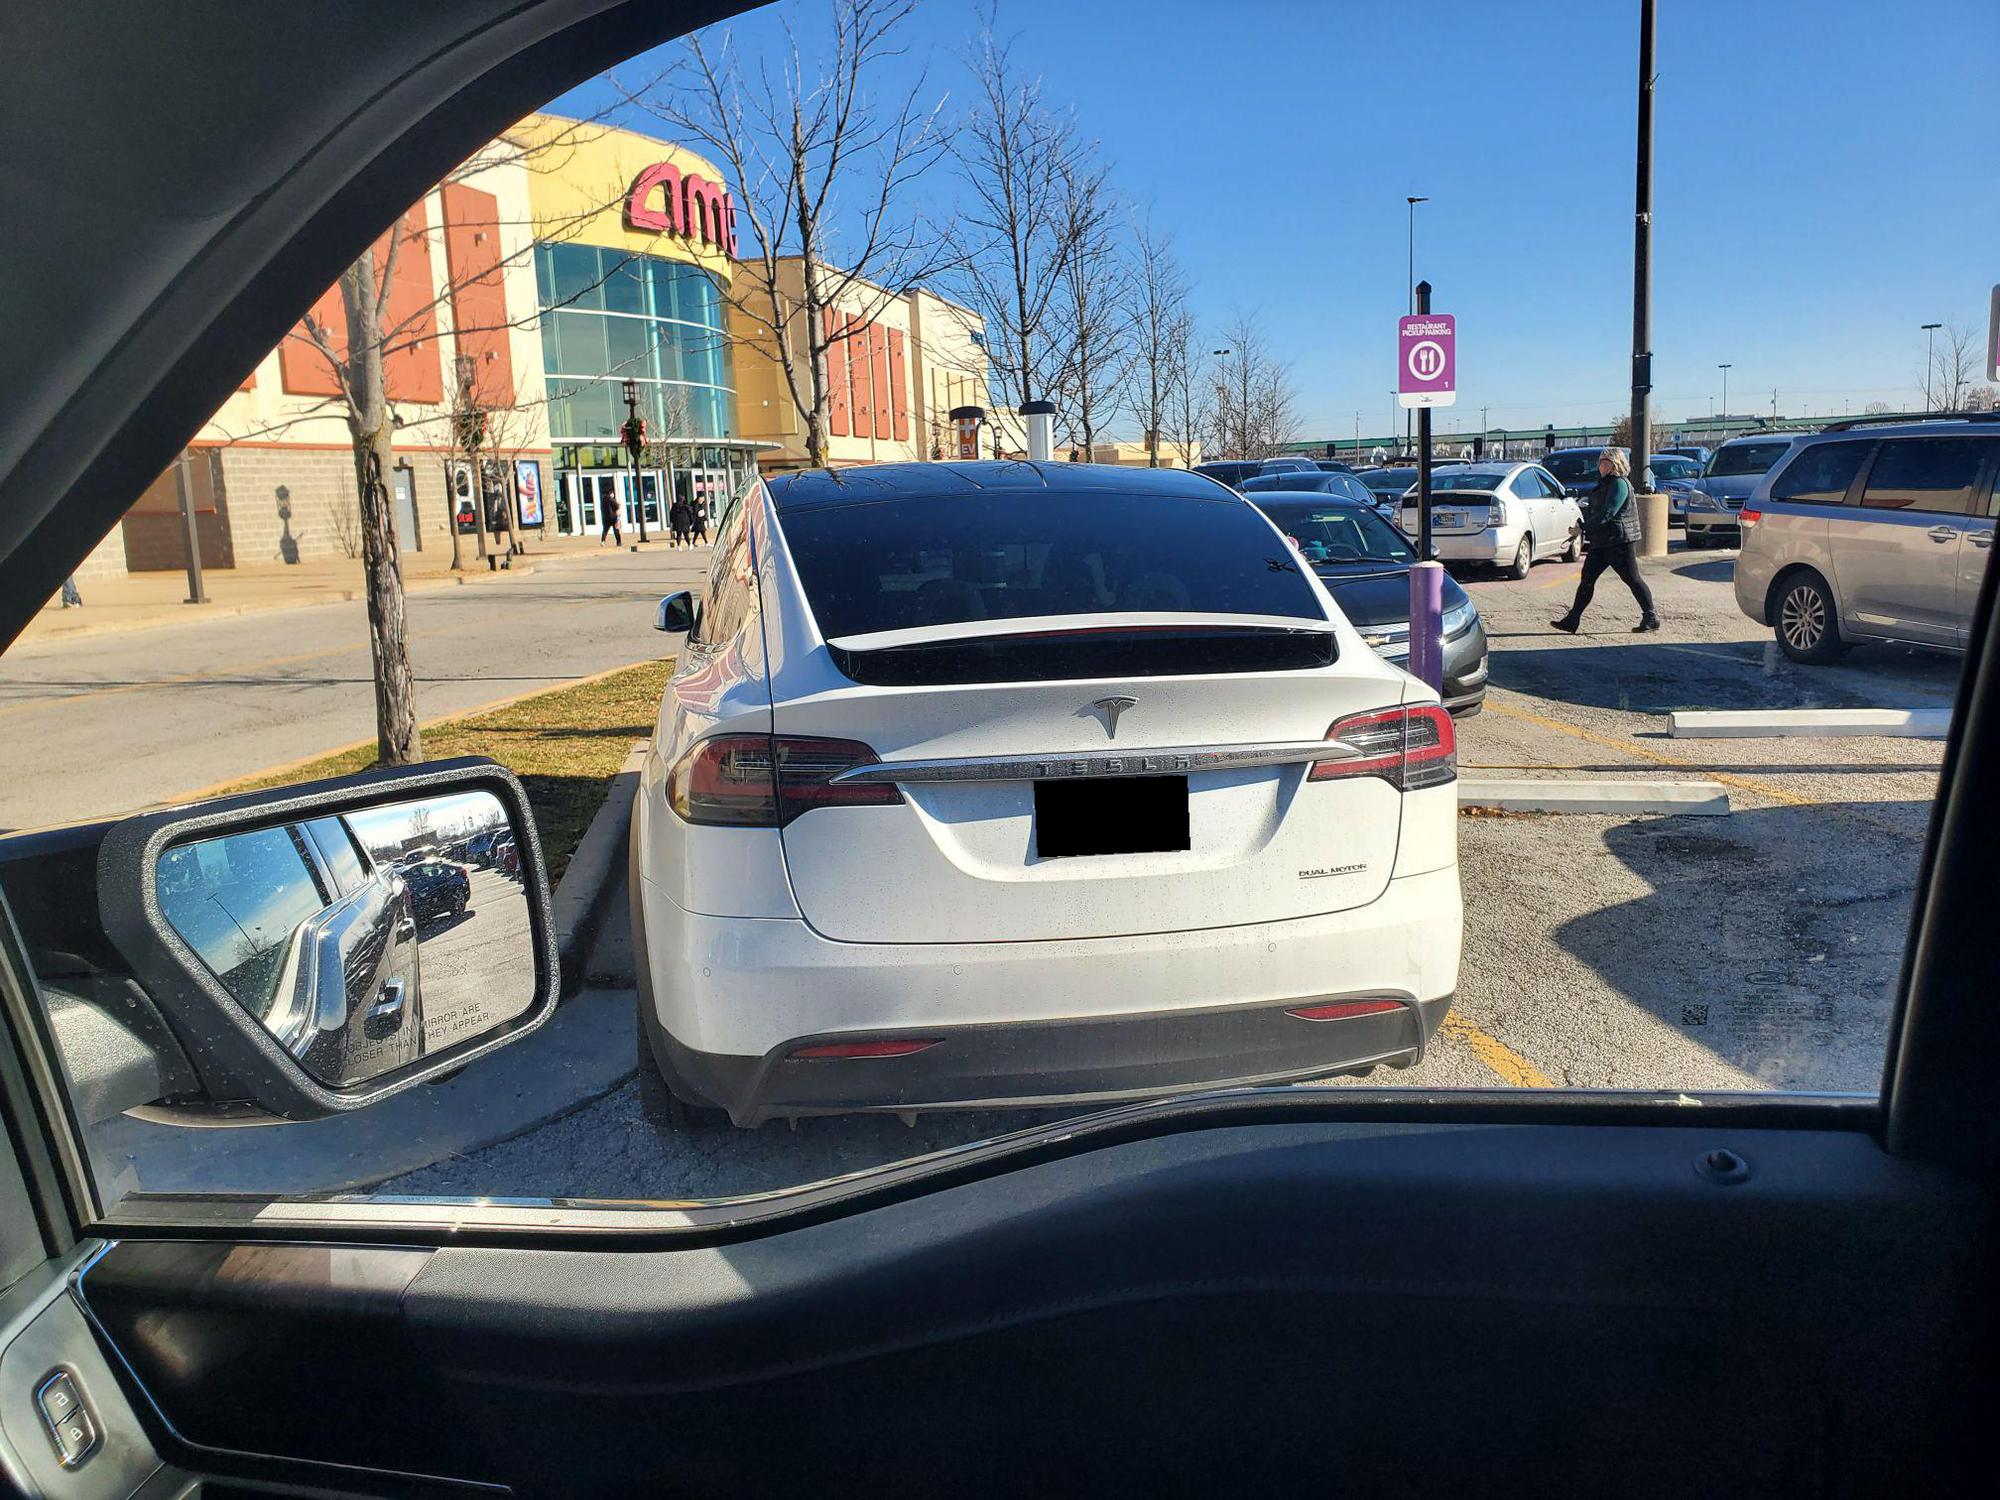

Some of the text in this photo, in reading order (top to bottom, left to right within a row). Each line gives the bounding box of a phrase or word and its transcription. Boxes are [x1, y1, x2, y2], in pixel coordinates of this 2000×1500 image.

[1407, 322, 1447, 330] RESTAURANT
[1425, 328, 1451, 336] PARKING
[1035, 754, 1190, 776] TESLA
[1298, 863, 1367, 877] DUAL MOTOR
[402, 1024, 414, 1037] IN
[462, 1002, 482, 1017] ARE
[342, 1046, 384, 1066] LOSER
[388, 1036, 418, 1053] THAN
[452, 1012, 490, 1031] APPEAR
